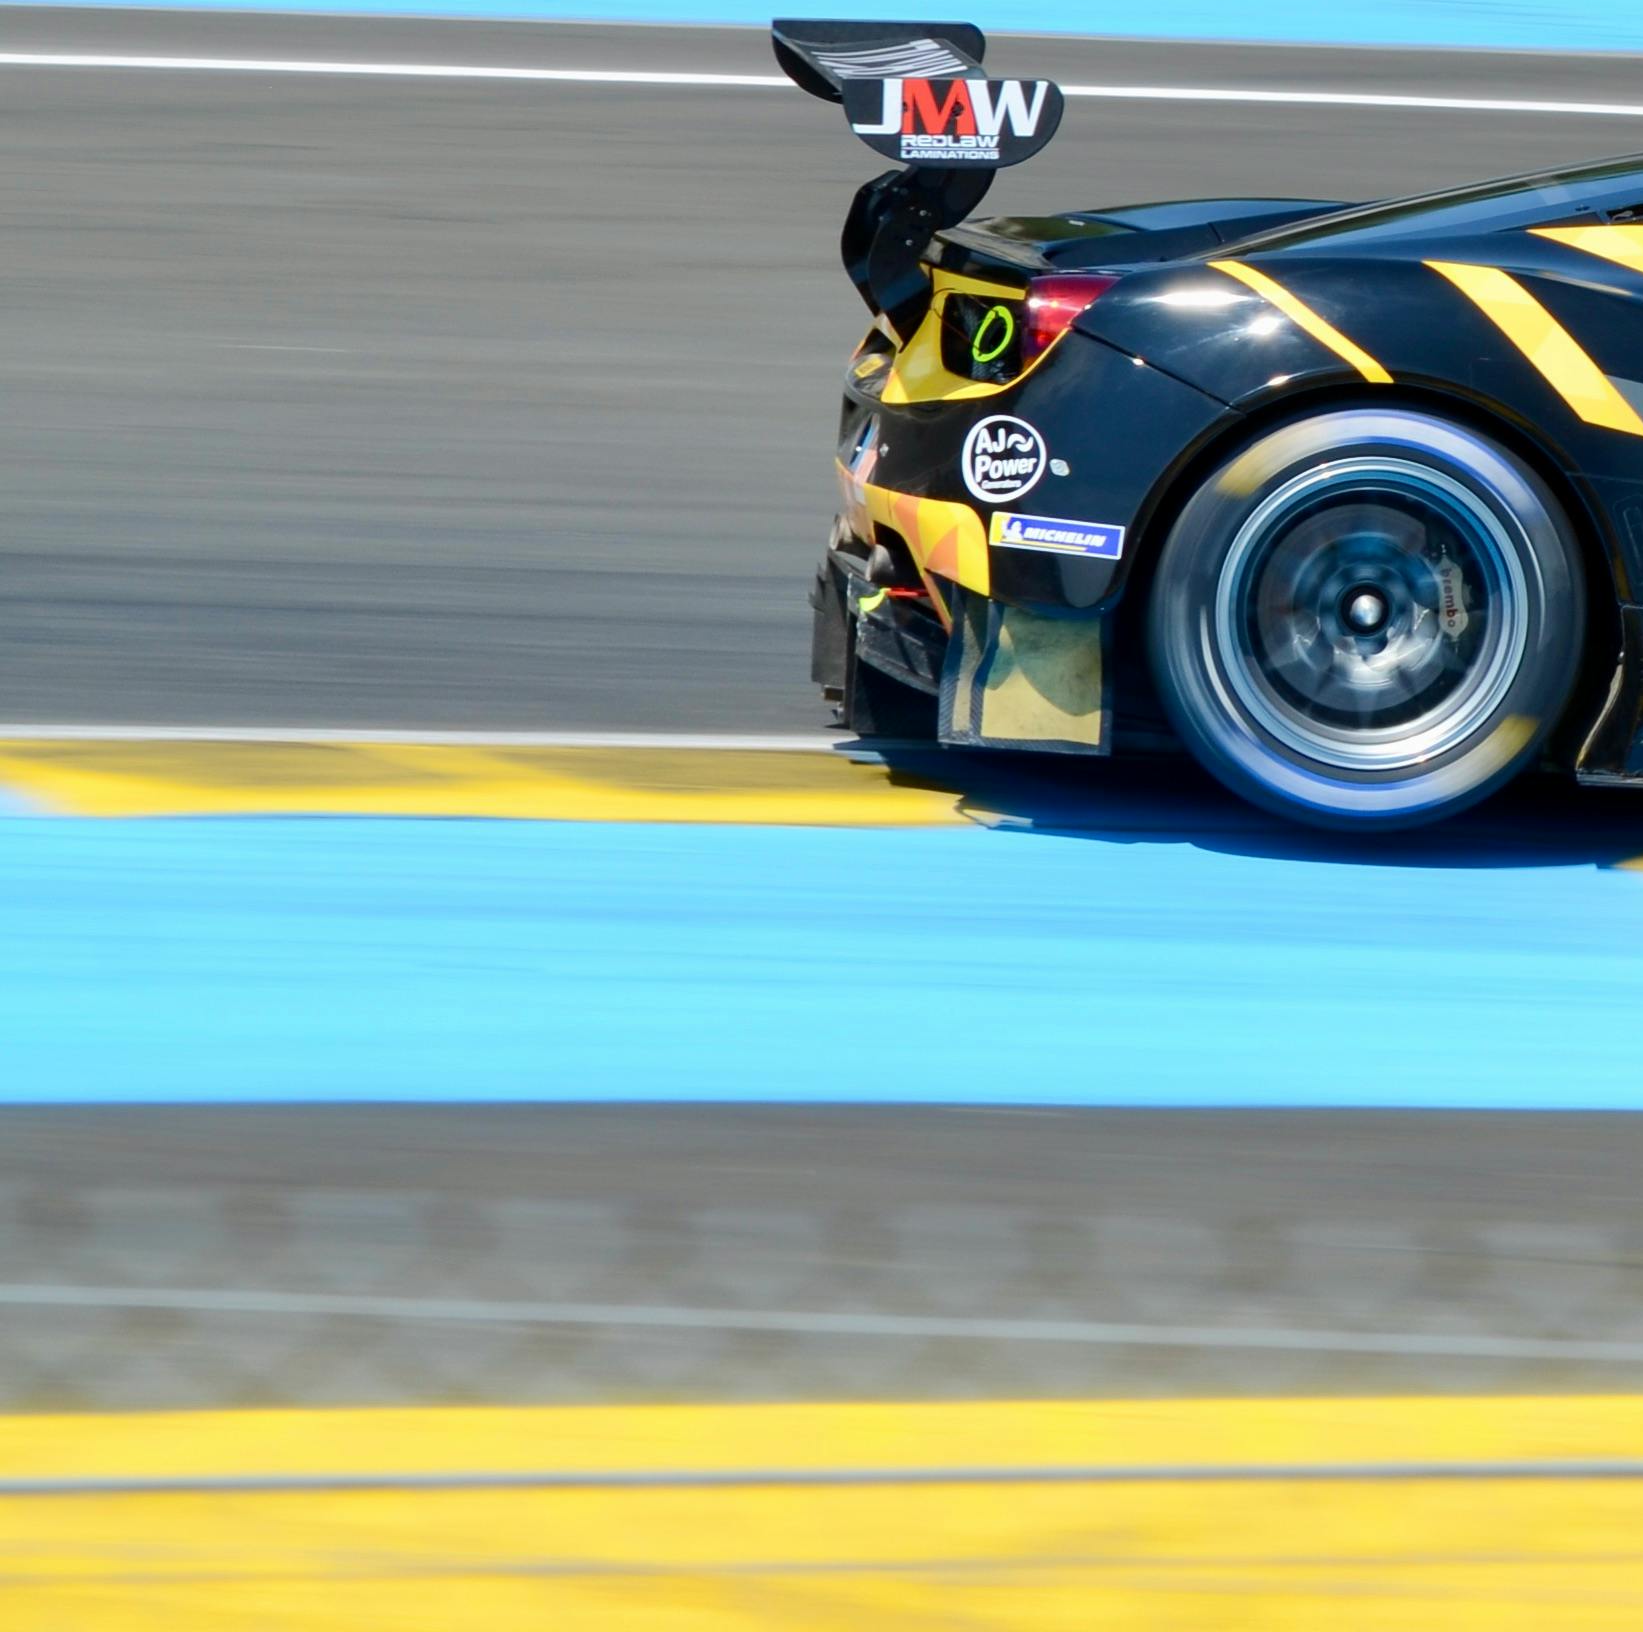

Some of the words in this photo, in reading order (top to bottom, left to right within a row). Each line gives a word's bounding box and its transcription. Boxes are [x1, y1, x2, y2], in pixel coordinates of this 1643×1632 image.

[852, 78, 1049, 137] JMW
[900, 149, 1000, 159] LAMINATIONS
[975, 428, 1006, 455] AJ
[975, 455, 1038, 483] Power
[1023, 527, 1107, 547] MICHELIN
[1441, 568, 1458, 628] brembo
